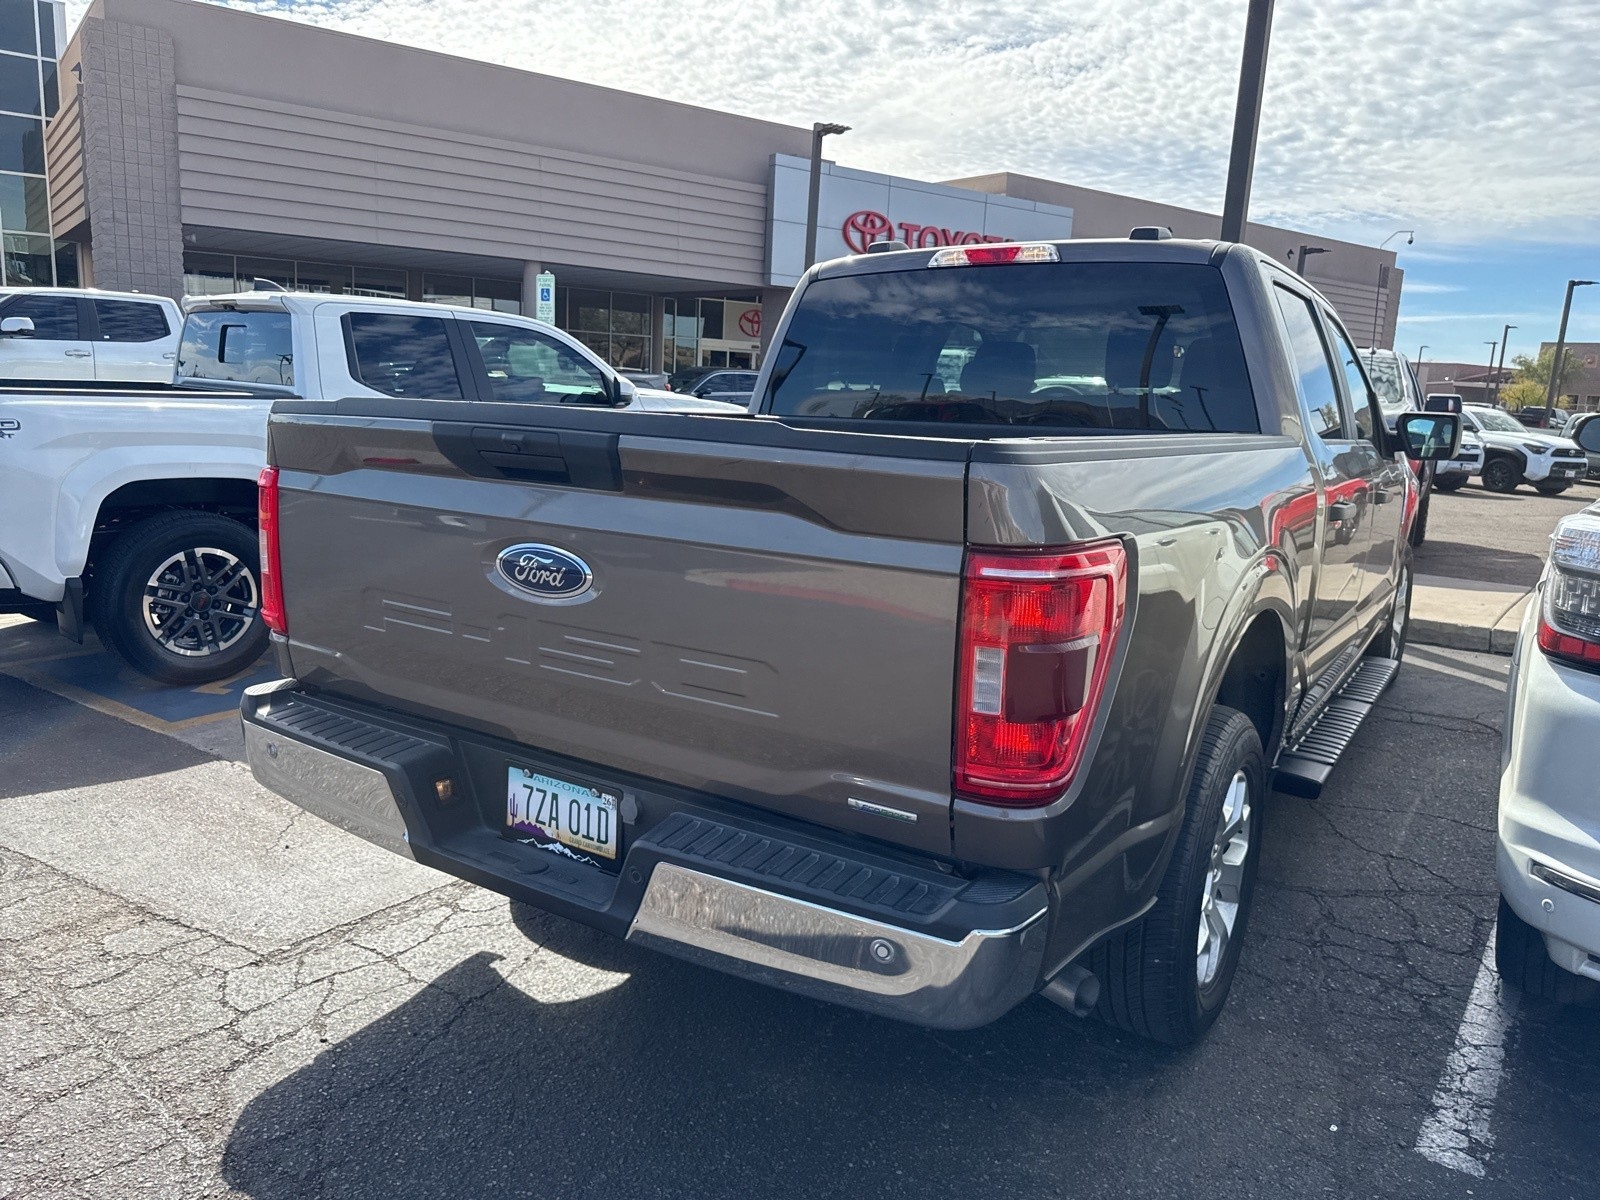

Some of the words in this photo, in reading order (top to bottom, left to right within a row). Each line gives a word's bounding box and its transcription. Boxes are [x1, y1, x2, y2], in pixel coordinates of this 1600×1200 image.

[514, 554, 565, 587] Ford
[363, 586, 780, 718] F-150
[533, 775, 591, 797] ARIZONA
[523, 783, 559, 830] 7ZA
